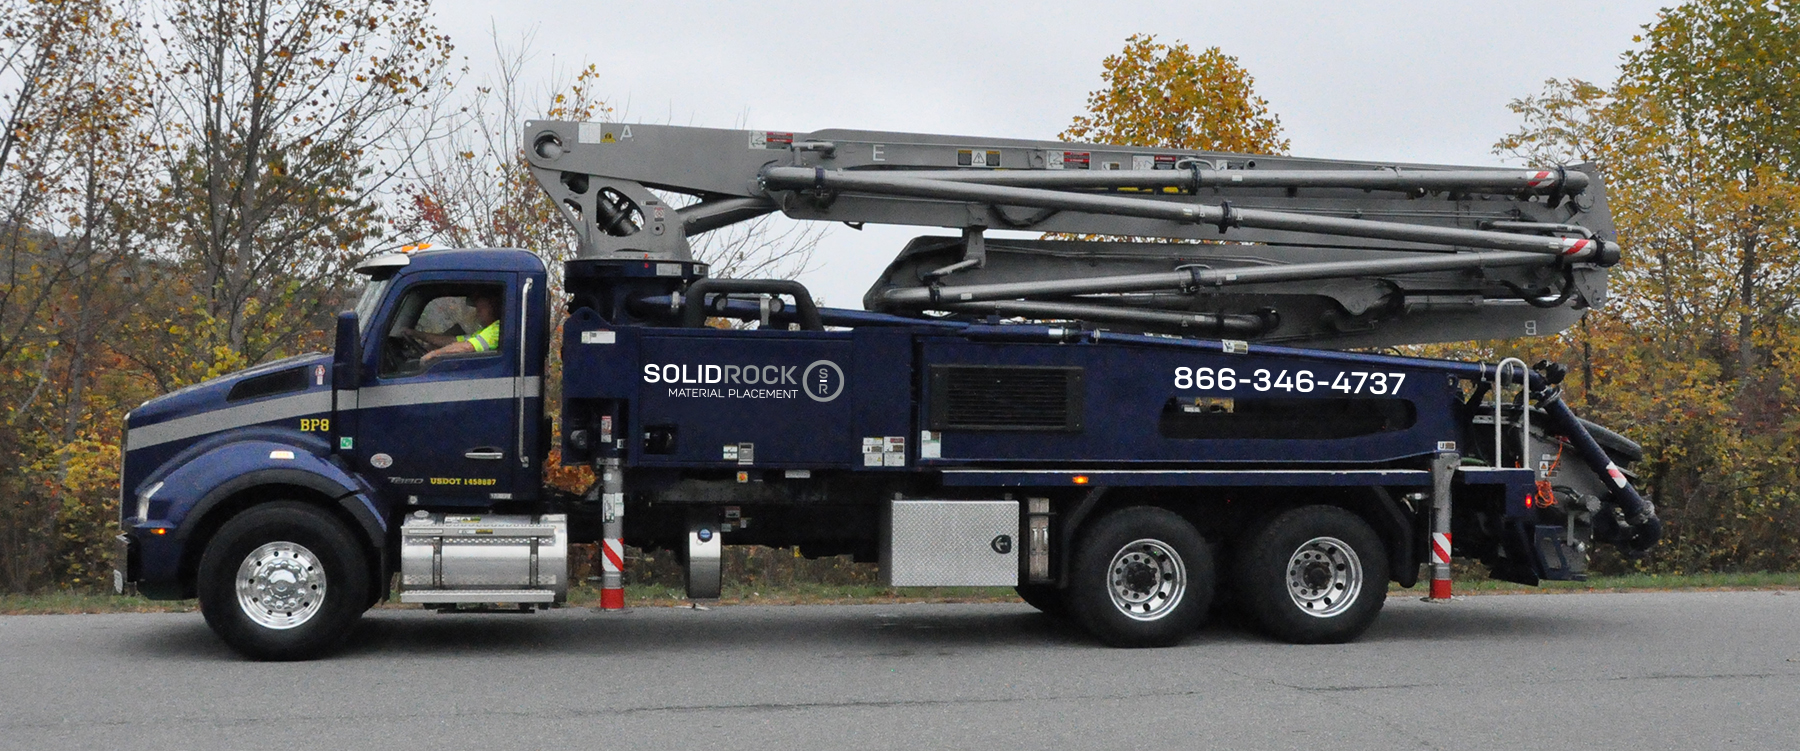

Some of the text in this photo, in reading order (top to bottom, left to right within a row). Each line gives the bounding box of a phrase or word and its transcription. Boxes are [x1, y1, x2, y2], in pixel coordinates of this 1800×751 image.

[620, 124, 635, 142] A
[872, 144, 886, 162] E
[1524, 320, 1537, 336] B
[643, 363, 798, 385] SOLIDROCK
[1173, 366, 1407, 395] 866-346-4737
[668, 388, 799, 399] MATERIAL PLACEMENT
[300, 418, 330, 432] BP8
[430, 477, 462, 486] USDOT
